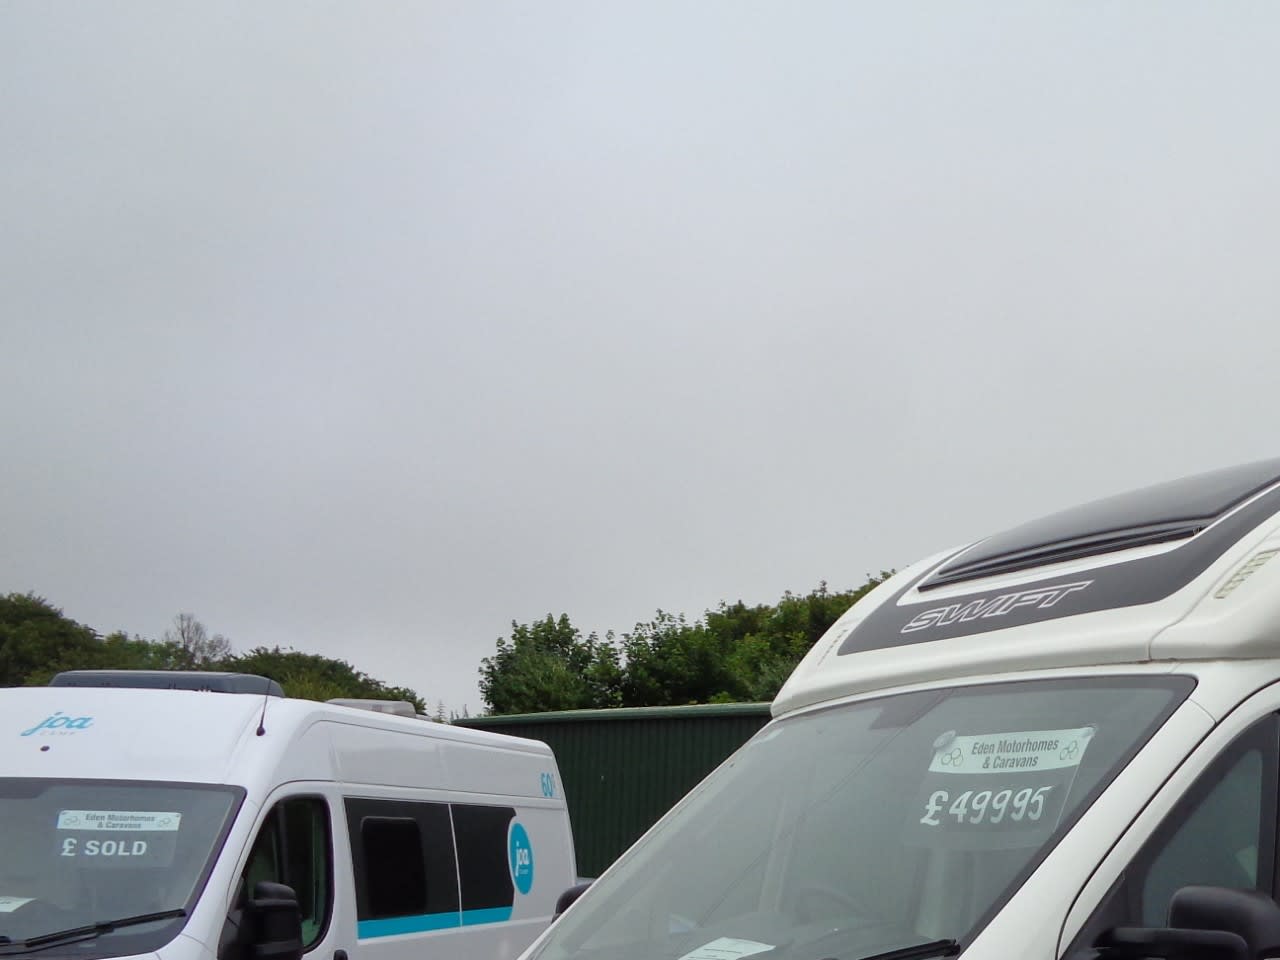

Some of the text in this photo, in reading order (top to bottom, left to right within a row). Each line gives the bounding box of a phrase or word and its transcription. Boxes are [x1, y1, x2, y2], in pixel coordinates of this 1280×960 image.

[901, 579, 1095, 633] SWIFT
[20, 711, 94, 737] joa
[971, 738, 1060, 756] Eden Motorhomes
[982, 755, 1039, 769] & Caravans
[85, 813, 156, 822] Eden Motorhomes
[84, 840, 148, 856] SOLD
